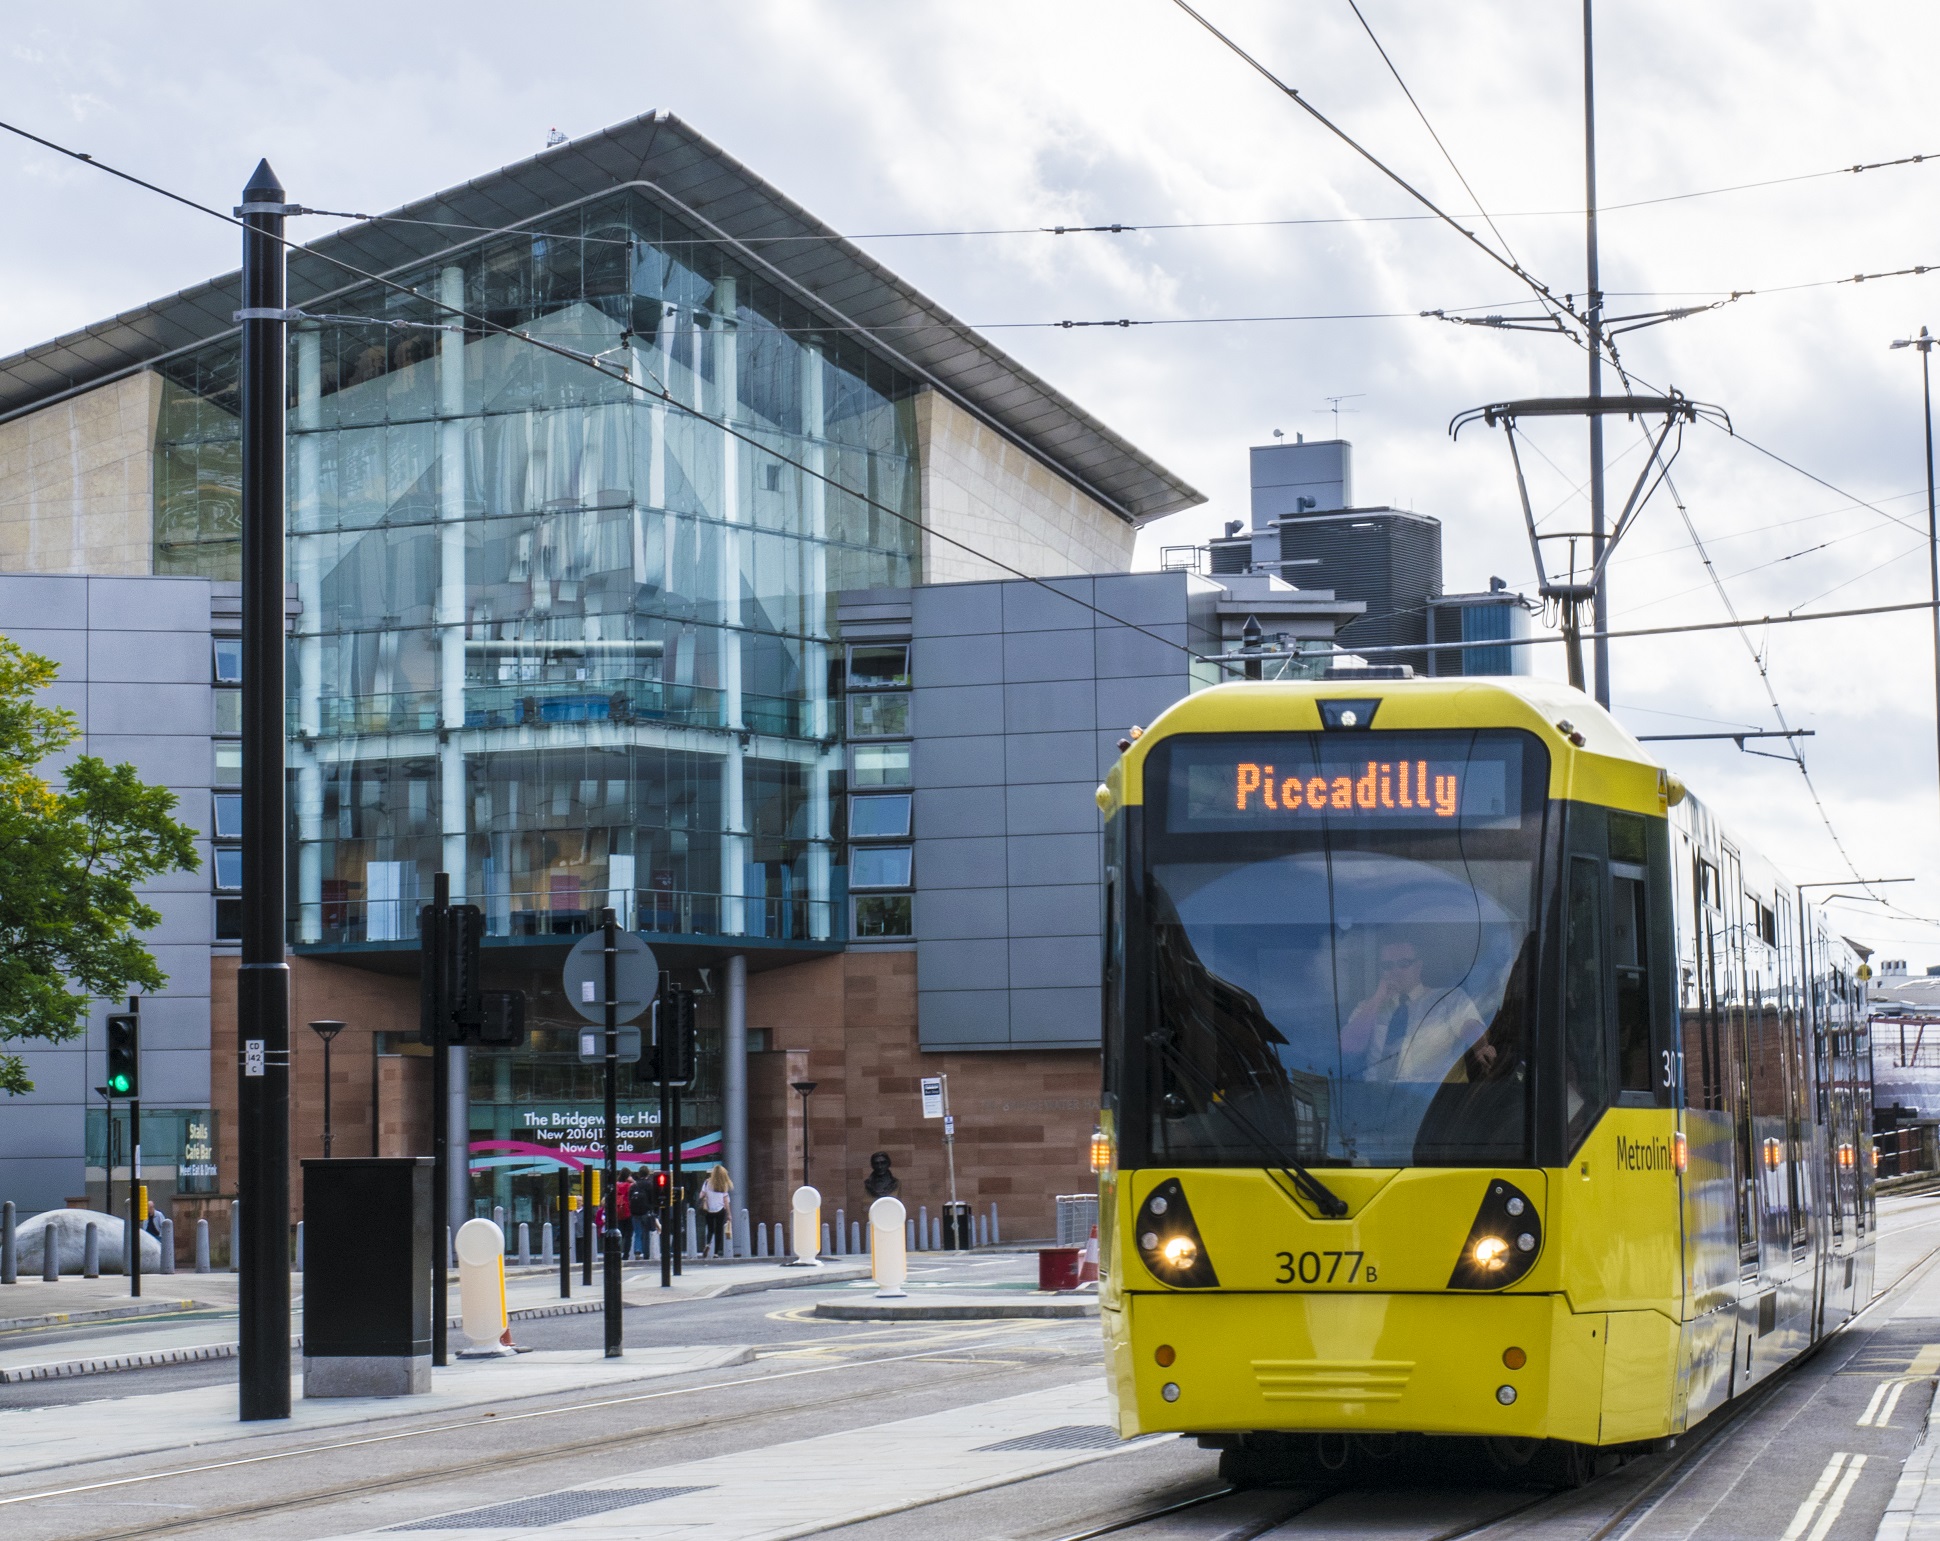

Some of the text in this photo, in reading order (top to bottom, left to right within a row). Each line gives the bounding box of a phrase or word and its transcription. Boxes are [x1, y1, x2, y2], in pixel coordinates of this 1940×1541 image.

[1236, 760, 1456, 816] Piccadilly
[249, 1042, 260, 1050] CD
[247, 1054, 261, 1062] 142
[251, 1065, 258, 1073] C
[523, 1109, 661, 1128] The Bridgewter Hal
[189, 1123, 208, 1139] Stalls
[537, 1129, 564, 1140] New
[566, 1128, 606, 1141] 2016|1
[185, 1142, 212, 1160] Café Bar
[560, 1142, 587, 1153] Now
[616, 1139, 634, 1152] ale
[179, 1163, 217, 1176] Meet Eat & Drink
